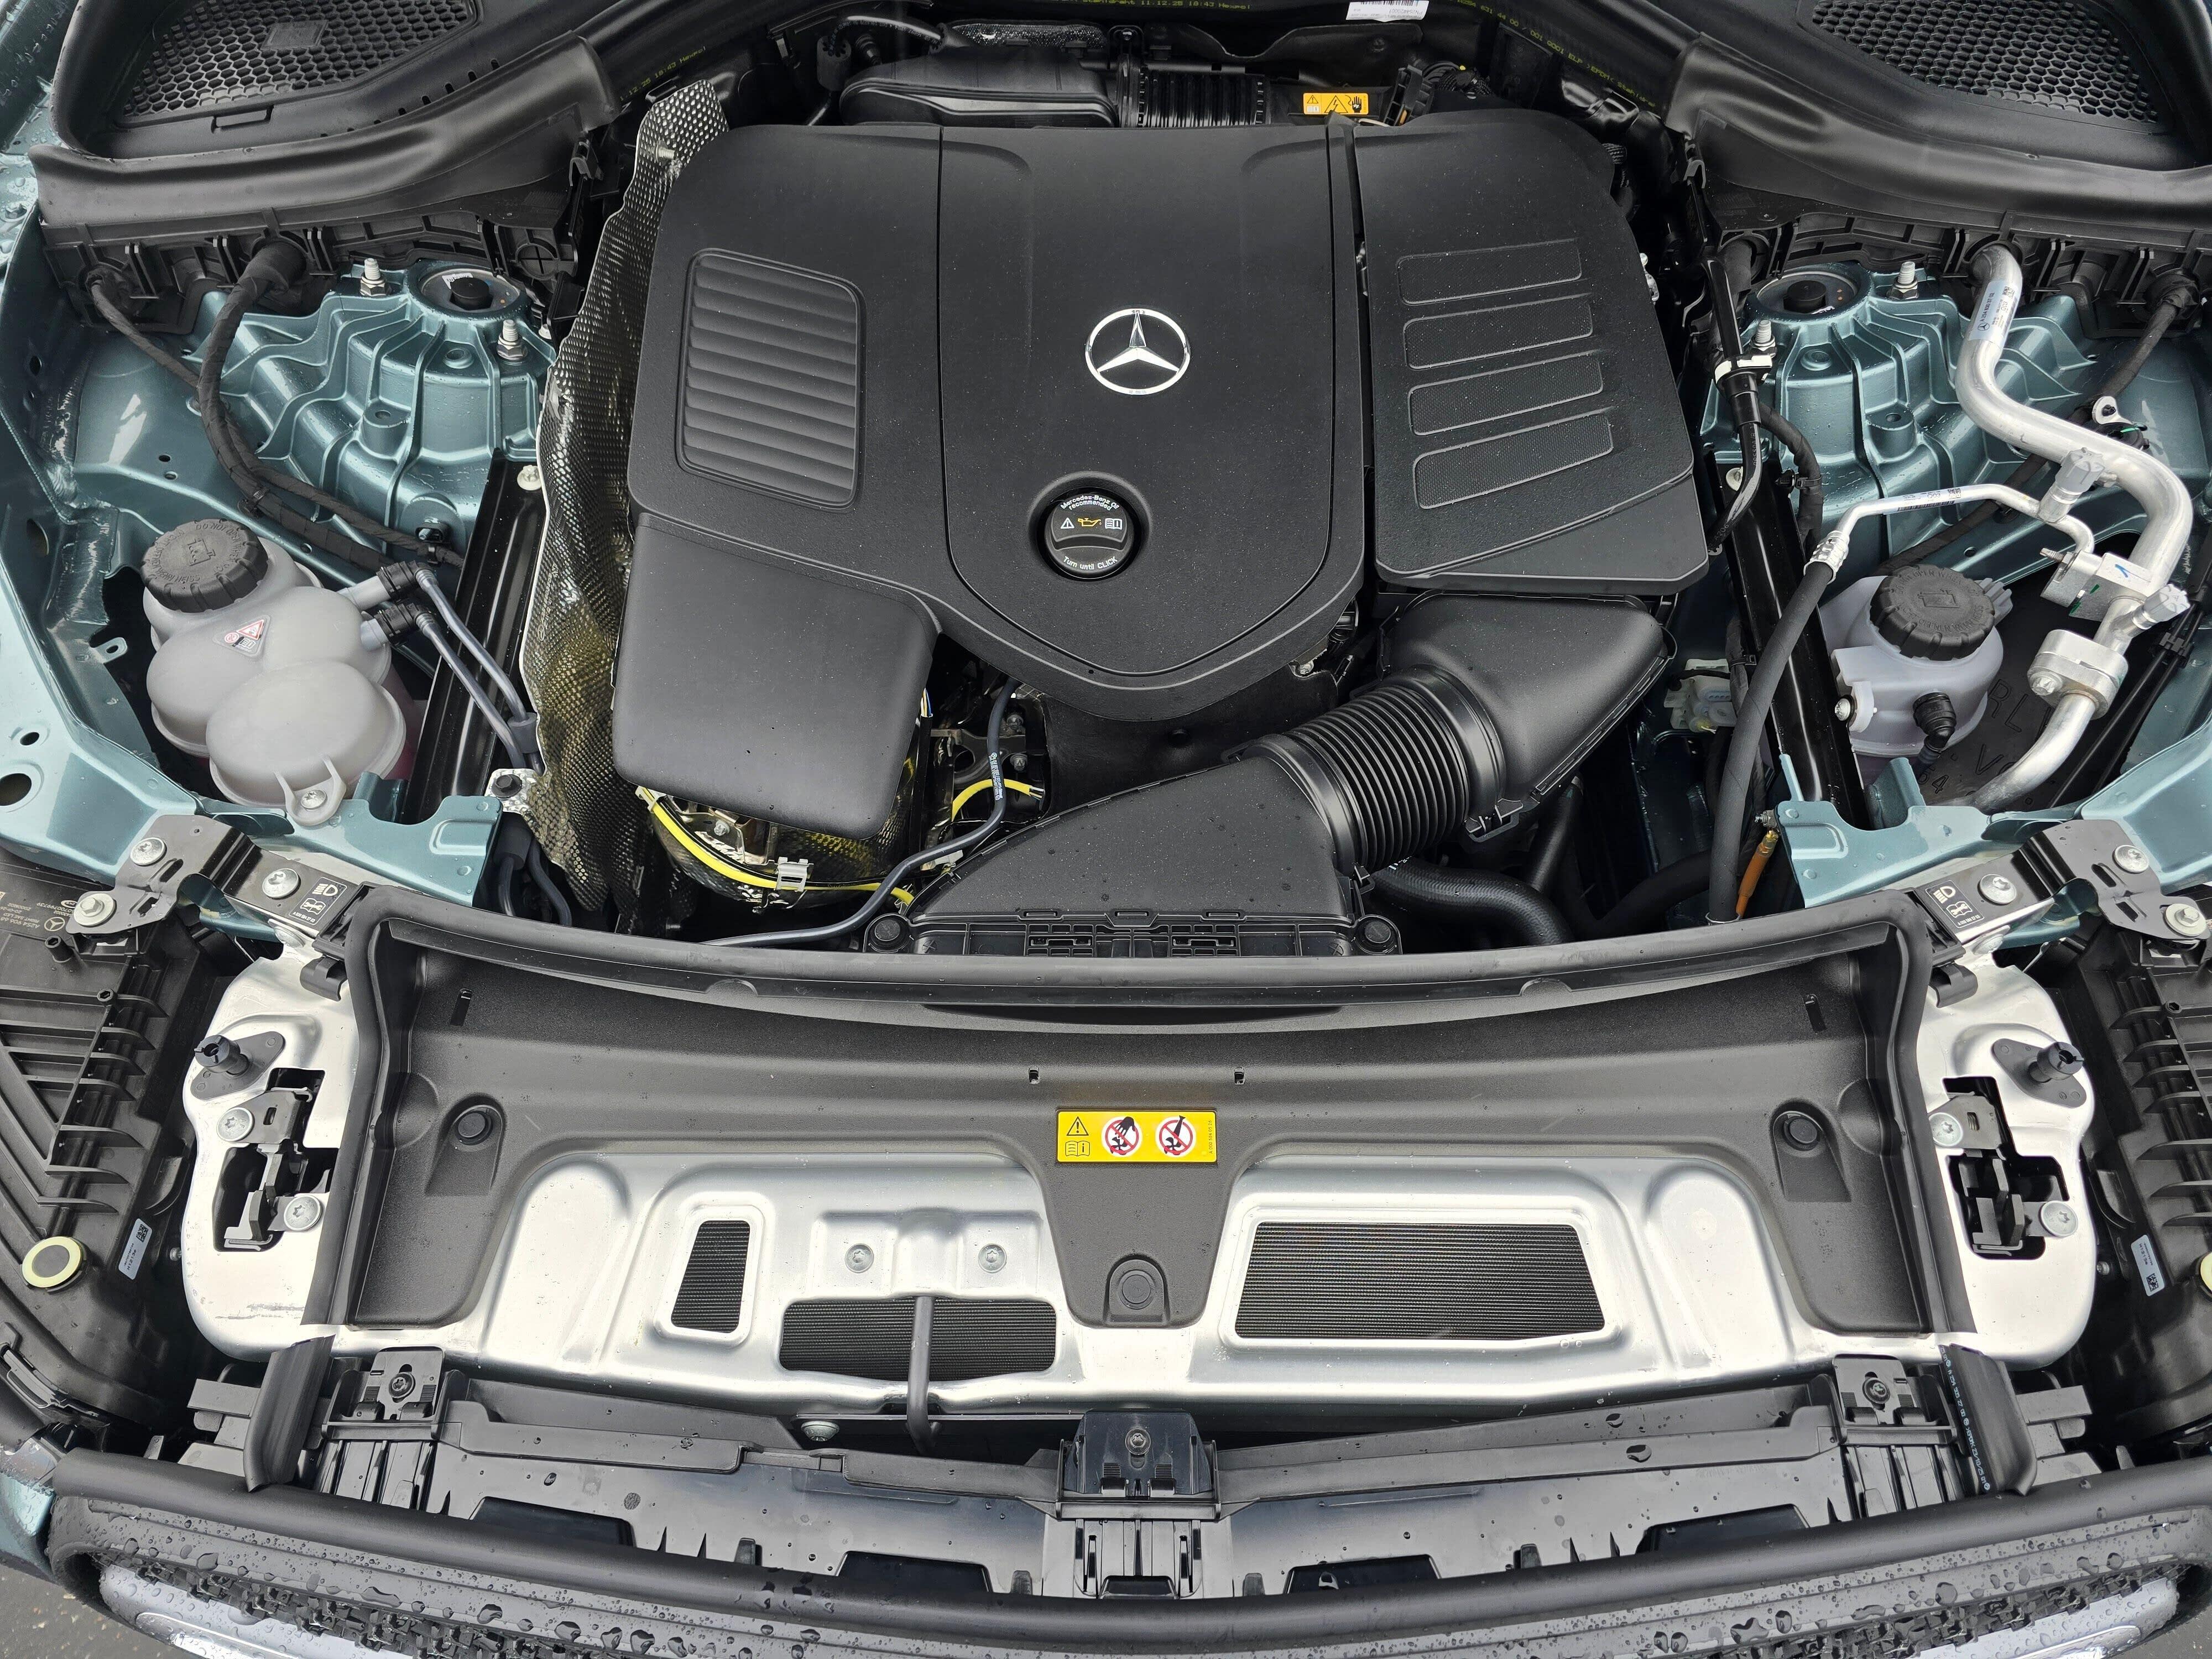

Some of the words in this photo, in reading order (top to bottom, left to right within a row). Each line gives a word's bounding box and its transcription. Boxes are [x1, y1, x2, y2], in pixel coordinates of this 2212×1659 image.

[1061, 495, 1110, 509] Mercedes-Benz
[1069, 500, 1112, 511] recommended
[1063, 556, 1077, 568] Turn
[1097, 556, 1118, 569] CLICK
